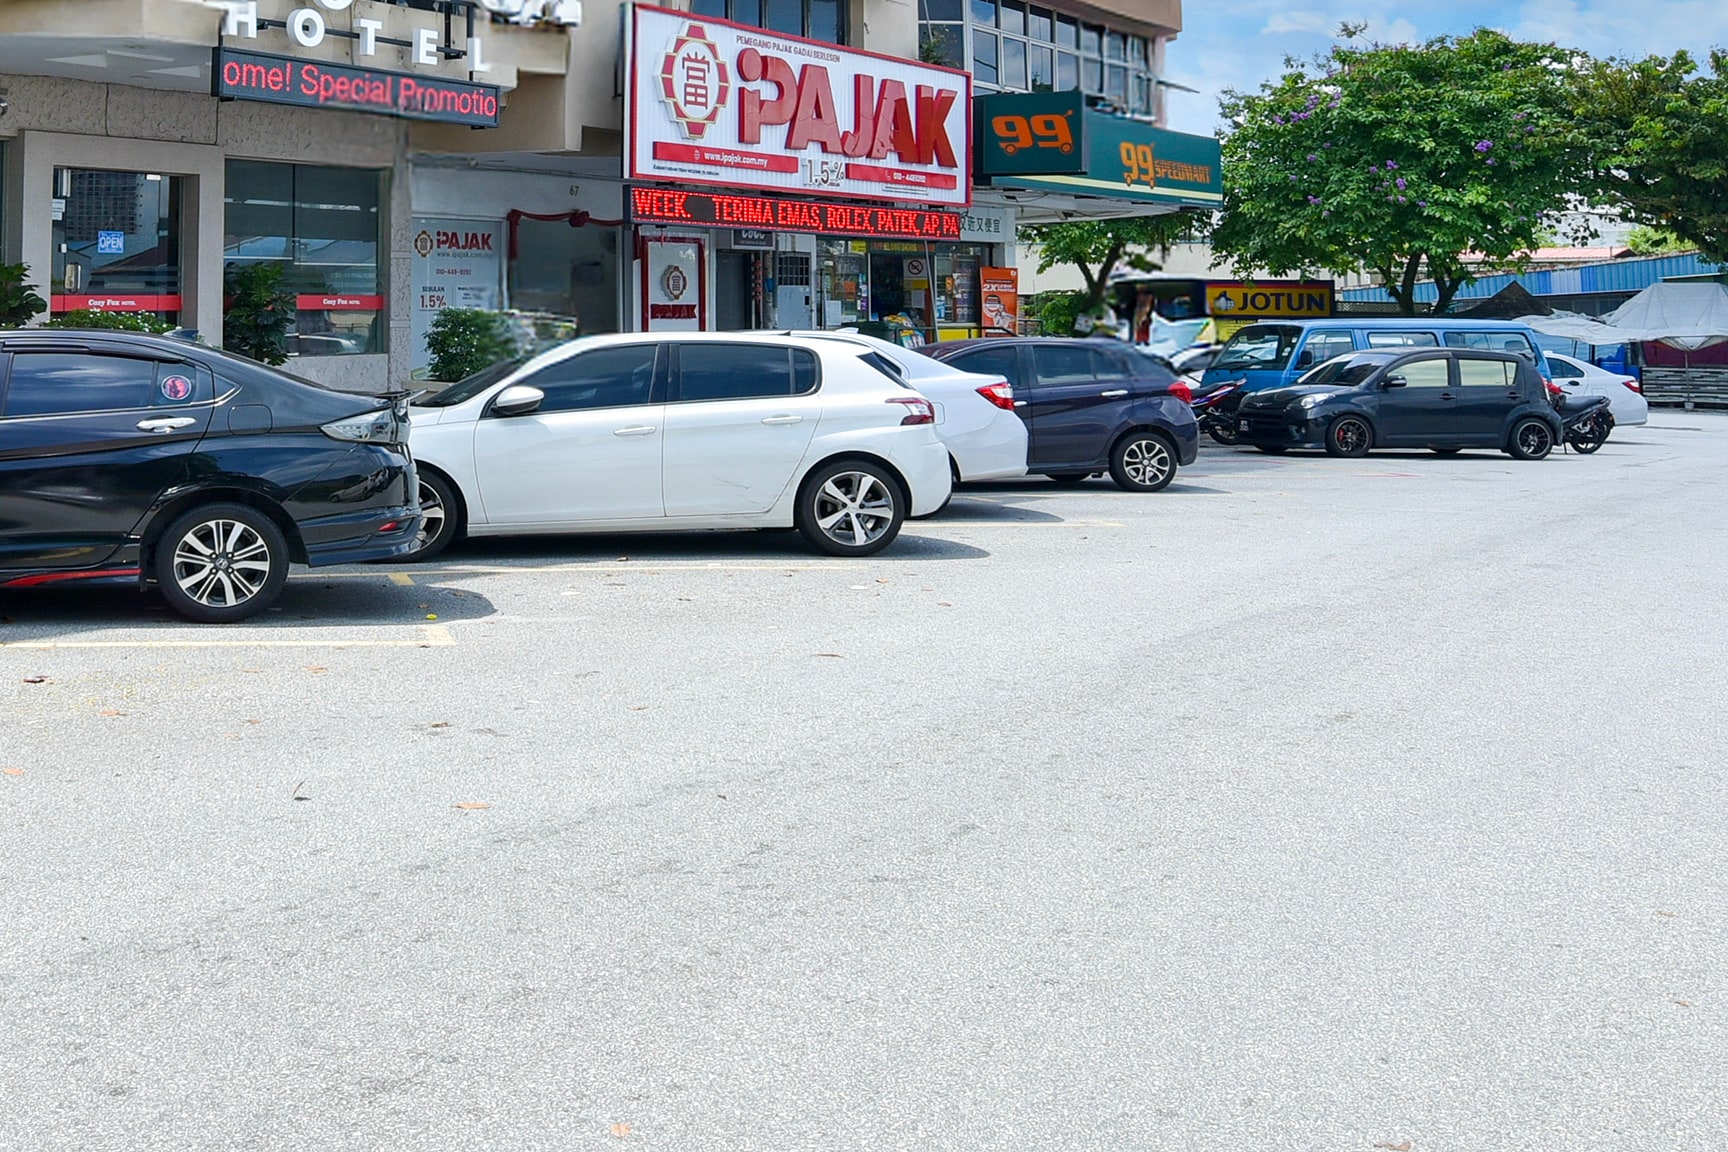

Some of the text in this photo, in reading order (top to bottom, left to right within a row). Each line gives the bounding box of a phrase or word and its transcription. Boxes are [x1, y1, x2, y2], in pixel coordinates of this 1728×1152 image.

[222, 1, 491, 74] HOTEL
[223, 61, 497, 119] ome! Special Promotio
[737, 48, 958, 168] iPAJAK
[992, 111, 1073, 156] 99
[704, 151, 768, 168] www.ipajak.com.my
[1120, 142, 1211, 189] 99 SPEEDMART
[807, 159, 845, 184] 1.5%
[569, 184, 579, 196] 67
[634, 189, 959, 237] WEEK. TERIMA EMAS, ROLEX, PATEK, AP, PA
[100, 236, 122, 248] OPEN
[436, 231, 492, 250] iPAJAK
[88, 299, 105, 307] Cozy
[322, 298, 336, 306] Cozy
[420, 295, 446, 308] 1.5%
[1238, 292, 1325, 311] JOTUN
